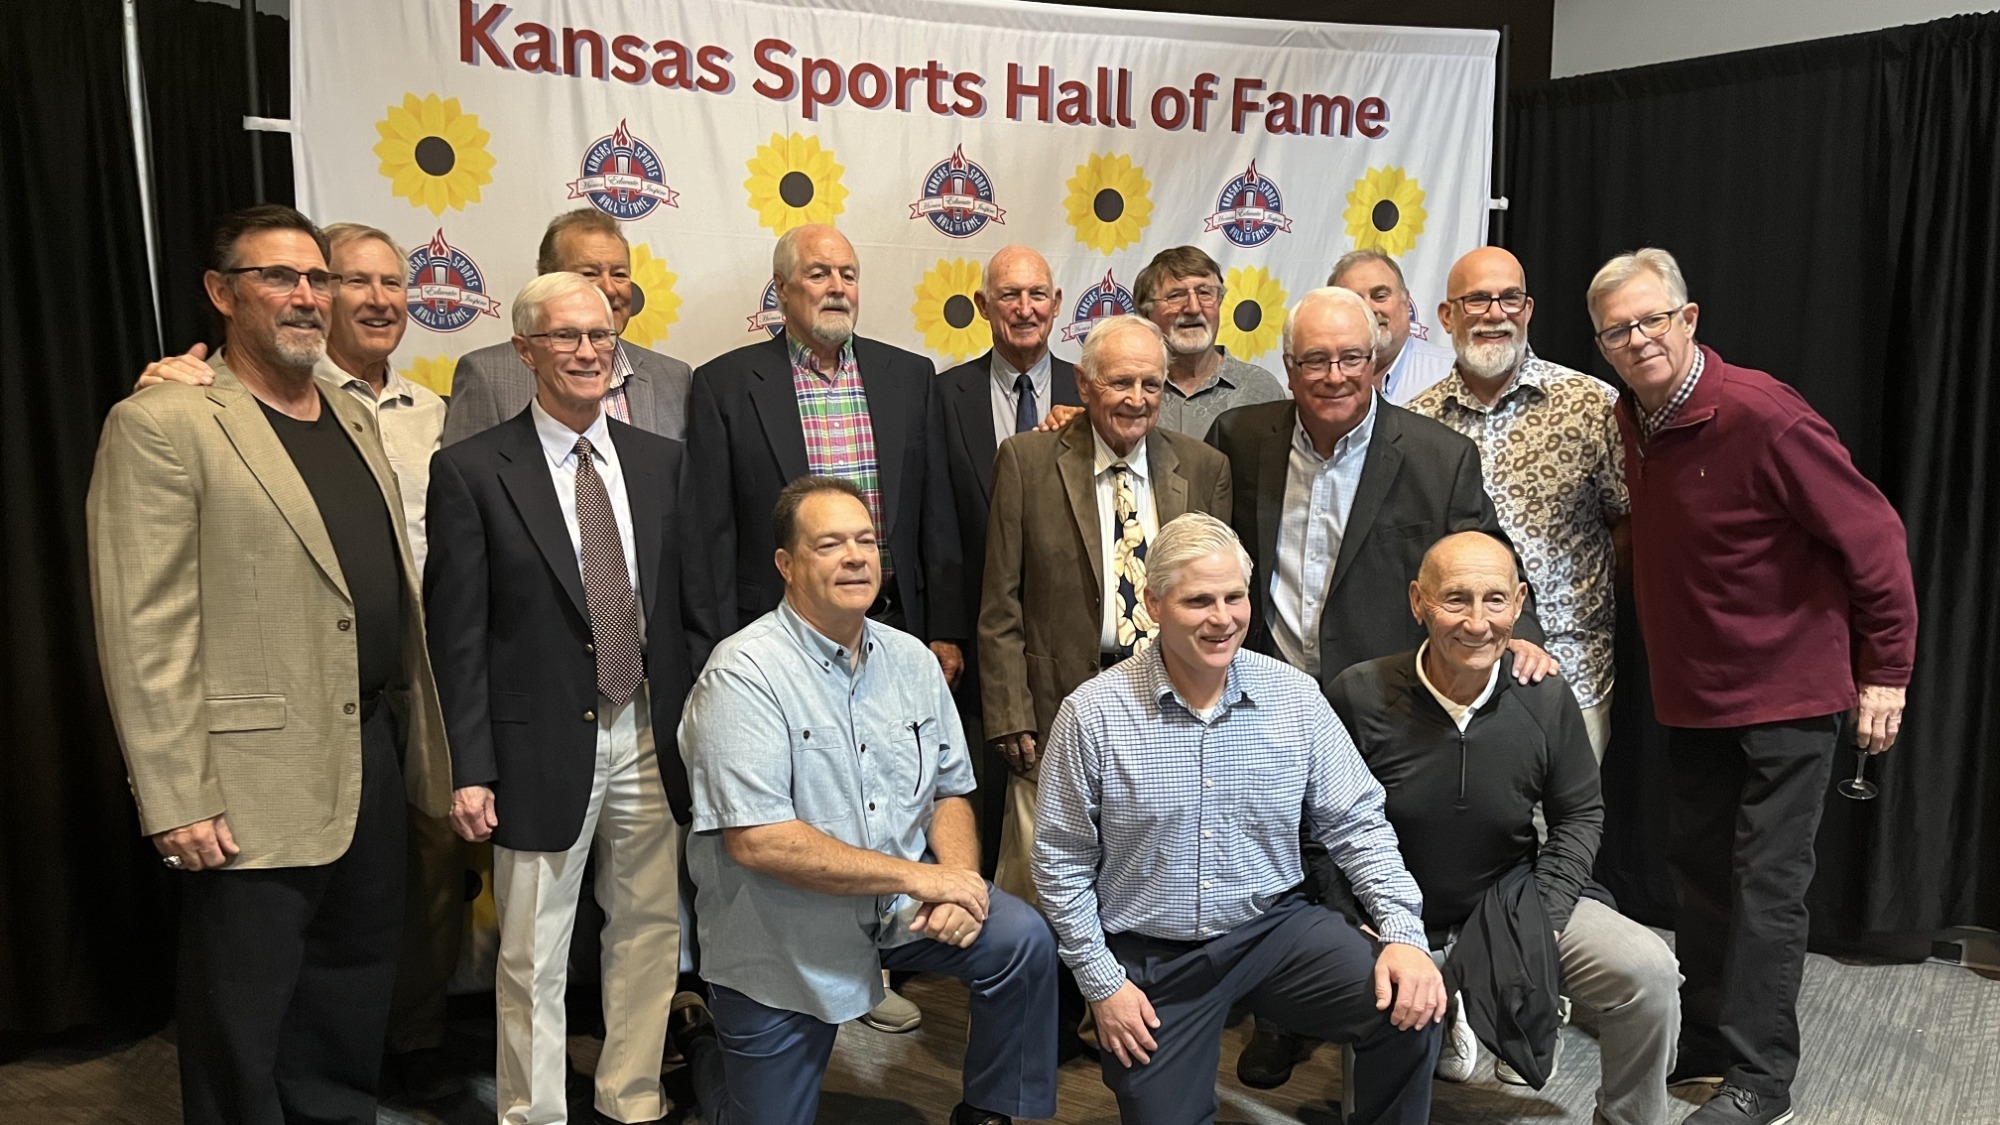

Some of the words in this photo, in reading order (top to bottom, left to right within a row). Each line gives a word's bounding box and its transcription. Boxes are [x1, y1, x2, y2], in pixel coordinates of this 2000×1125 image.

[458, 0, 735, 95] Kansas
[752, 38, 987, 121] Sports
[1006, 62, 1136, 129] Hall
[1150, 72, 1218, 132] of
[1232, 77, 1389, 139] Fame
[587, 143, 611, 173] KANSAS
[635, 146, 659, 177] SPORTS
[927, 166, 949, 195] KANSAS
[968, 168, 990, 197] SPORTS
[1221, 181, 1243, 207] KANSAS
[1259, 181, 1279, 207] SPORTS
[597, 194, 618, 214] HALL
[628, 196, 651, 215] FAME
[936, 214, 953, 232] HALL
[962, 215, 981, 232] FAME
[1228, 226, 1244, 242] HALL
[1251, 225, 1271, 242] FAME
[452, 256, 479, 287] SPORTS
[414, 305, 436, 325] HALL
[446, 308, 470, 326] FAME
[1077, 291, 1099, 318] KANSAS
